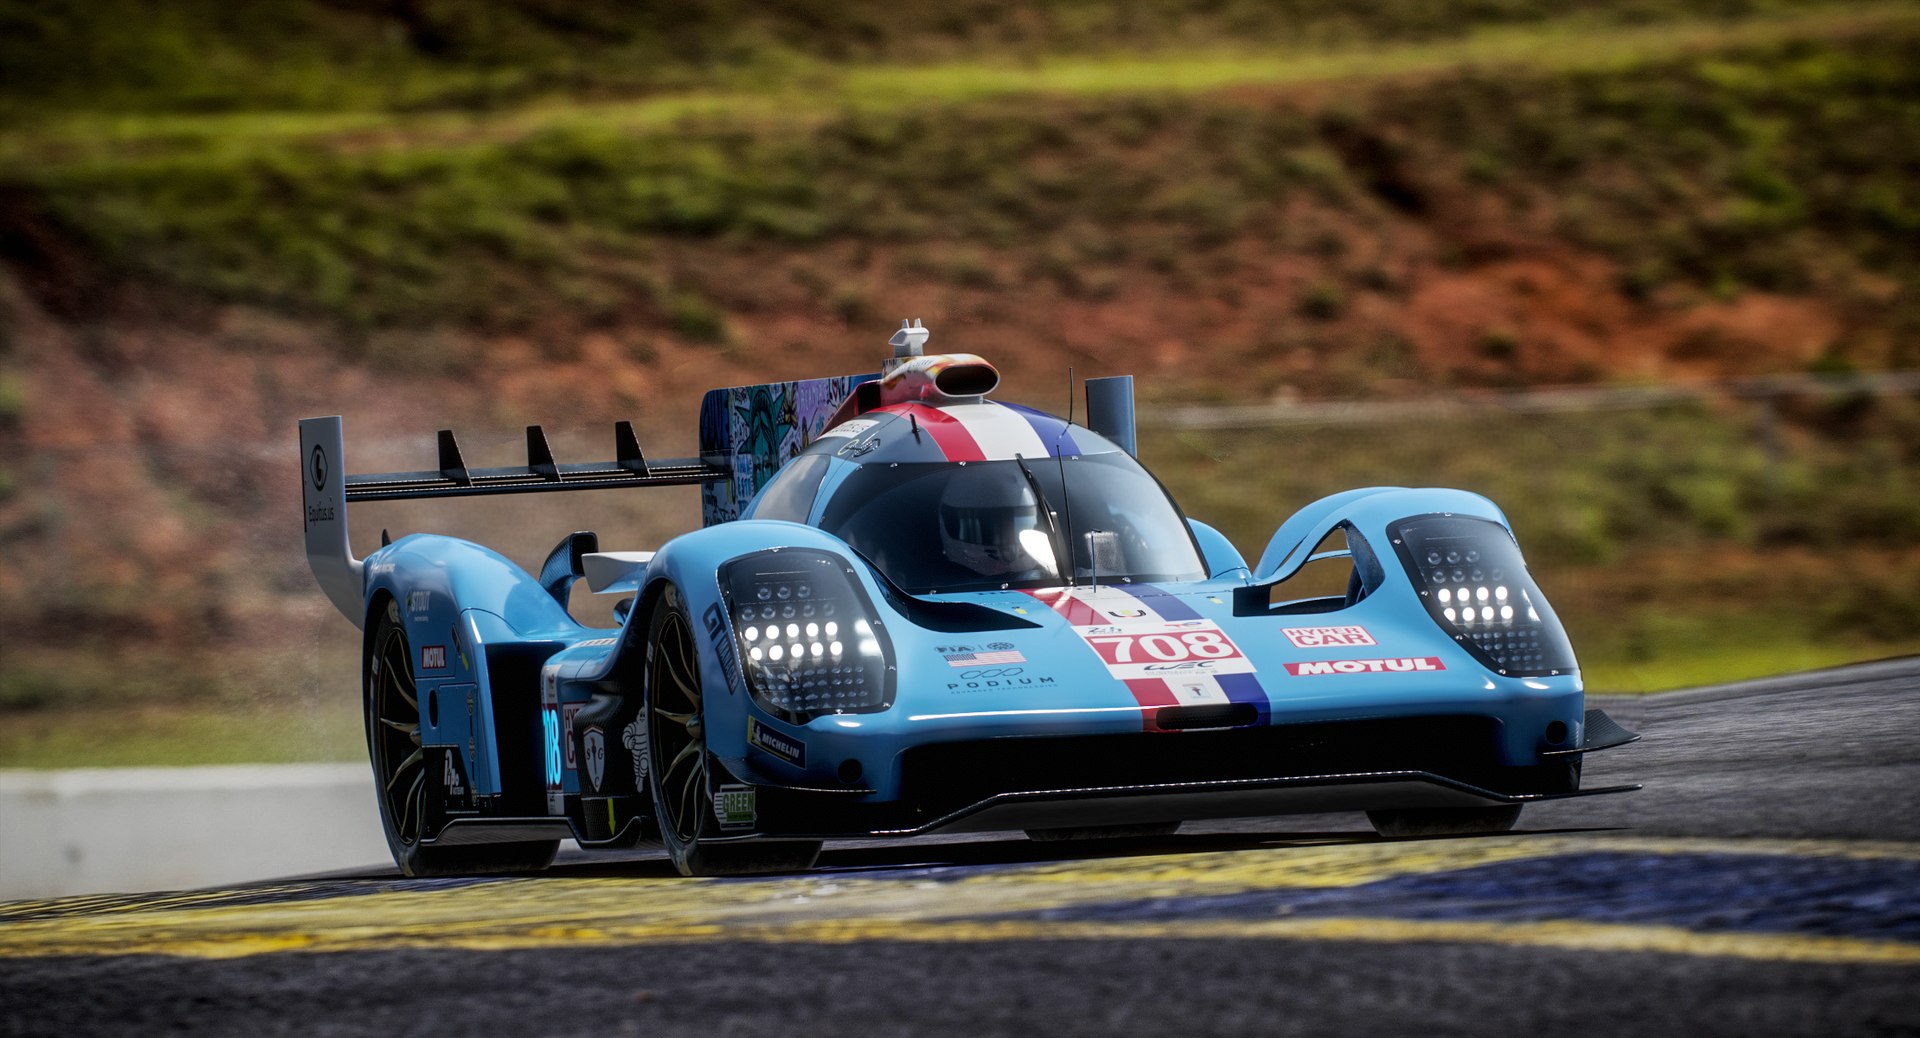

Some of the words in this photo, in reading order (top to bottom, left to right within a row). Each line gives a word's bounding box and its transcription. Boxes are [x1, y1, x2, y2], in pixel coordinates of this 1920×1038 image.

[703, 602, 727, 641] GT
[1287, 627, 1361, 636] HYPER
[1091, 632, 1234, 663] 708
[1295, 634, 1369, 646] CAR
[423, 647, 446, 668] MOTUL
[1298, 658, 1437, 675] MOTUL
[947, 677, 1055, 690] PODIUM
[762, 734, 800, 759] MICHELIN
[723, 793, 754, 813] GREEN
